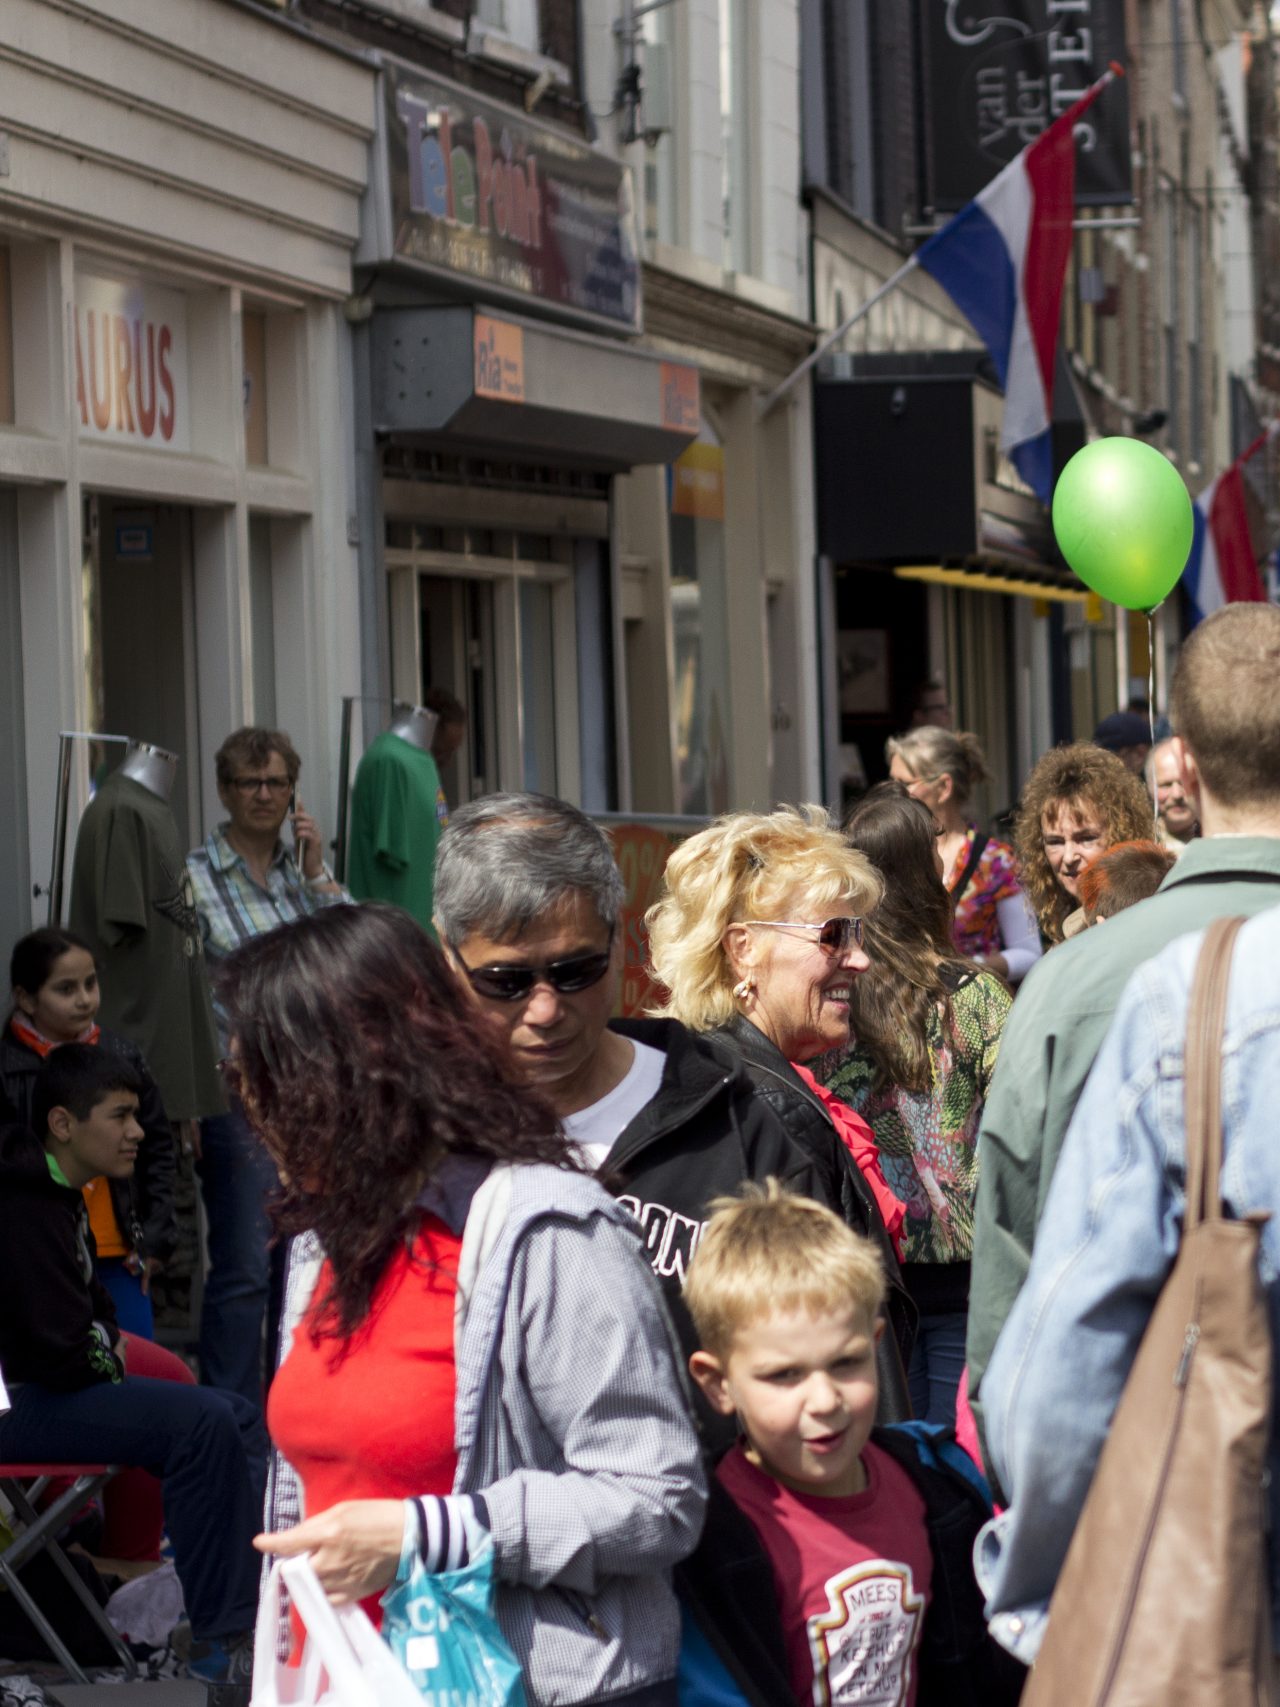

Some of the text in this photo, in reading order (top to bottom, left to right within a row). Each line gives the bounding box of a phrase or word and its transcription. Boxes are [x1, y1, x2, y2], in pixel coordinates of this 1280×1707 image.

[976, 67, 1007, 147] van
[1004, 70, 1047, 142] der
[396, 87, 541, 249] Tele Point
[850, 1584, 897, 1610] MEES
[840, 1640, 903, 1663] KECHUP
